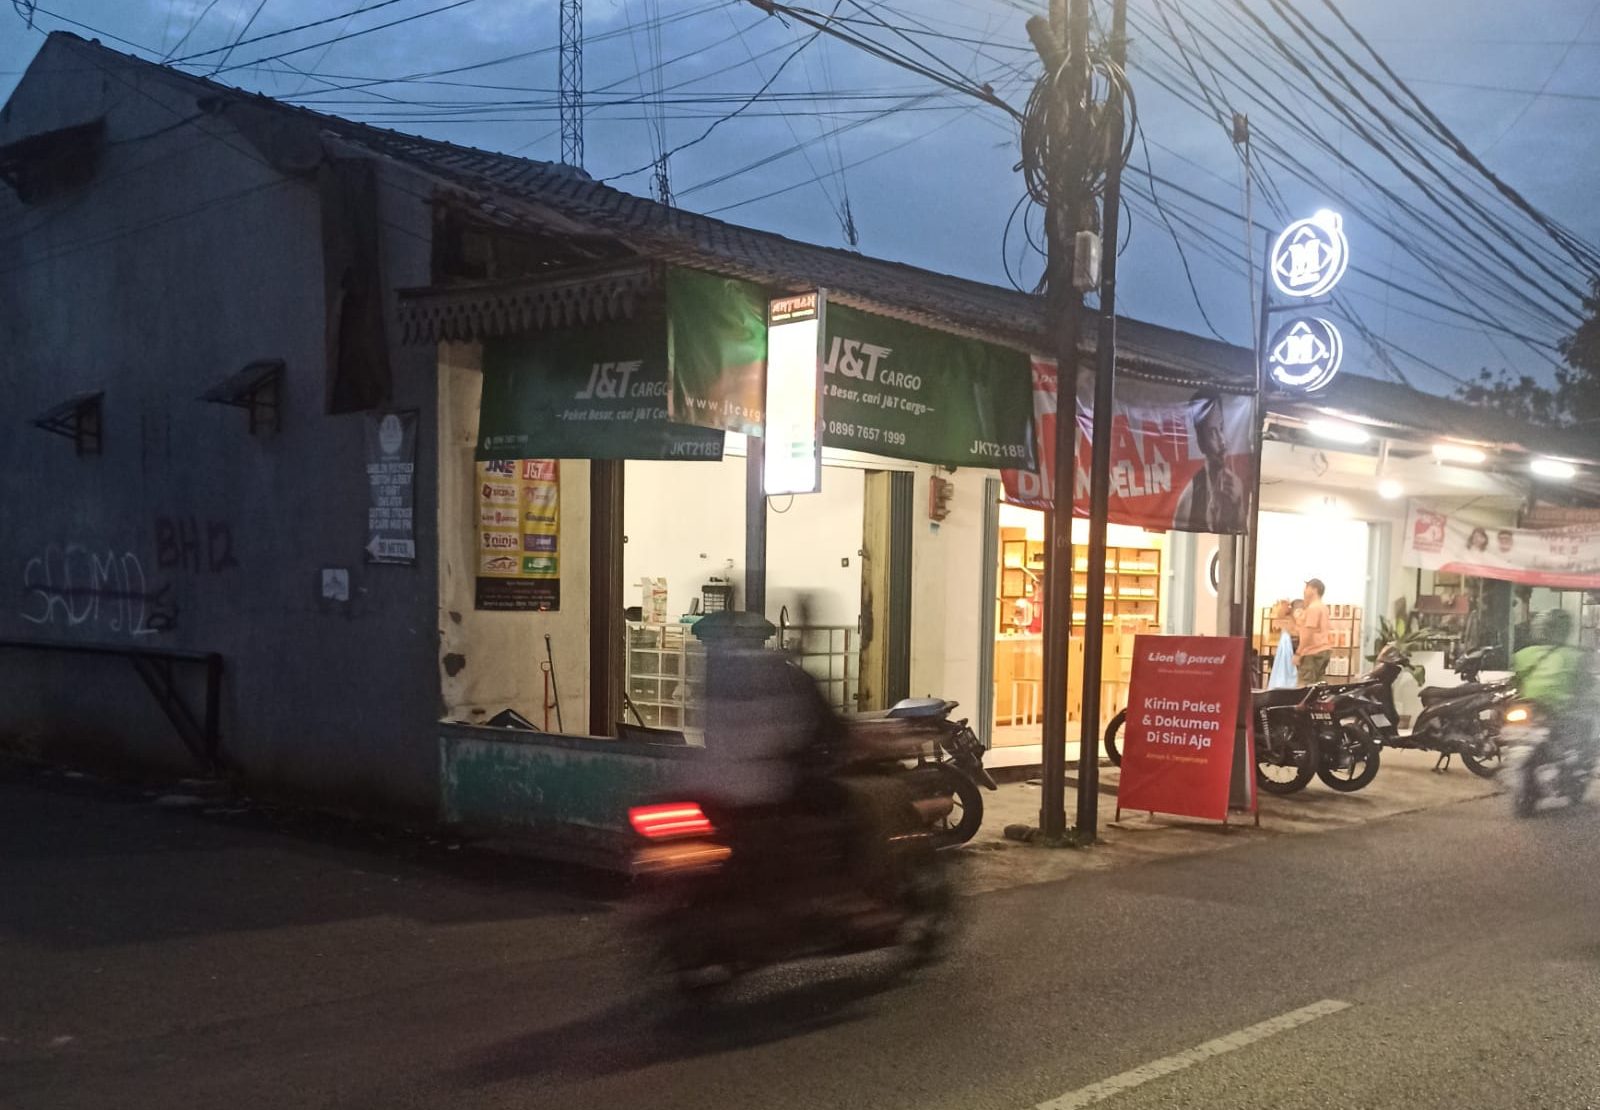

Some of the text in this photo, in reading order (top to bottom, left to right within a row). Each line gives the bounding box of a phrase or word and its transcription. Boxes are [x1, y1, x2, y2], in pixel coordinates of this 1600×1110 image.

[824, 336, 921, 390] J&T CARGO
[575, 360, 643, 399] J&T
[830, 385, 859, 403] Besar,
[862, 393, 880, 404] cari
[881, 395, 899, 409] J&T
[900, 399, 926, 415] Cargo
[634, 408, 651, 421] J&T
[829, 421, 906, 445] 0896 7657 1999
[670, 442, 721, 456] JKT218B
[970, 440, 1025, 458] JKT218B
[491, 535, 518, 546] ninja
[487, 560, 518, 570] SAP
[1148, 652, 1226, 665] Lion parcel
[1144, 697, 1221, 713] Kirim Paket
[1142, 714, 1219, 731] & Dokumen
[1147, 731, 1211, 750] Di Sini Aja
